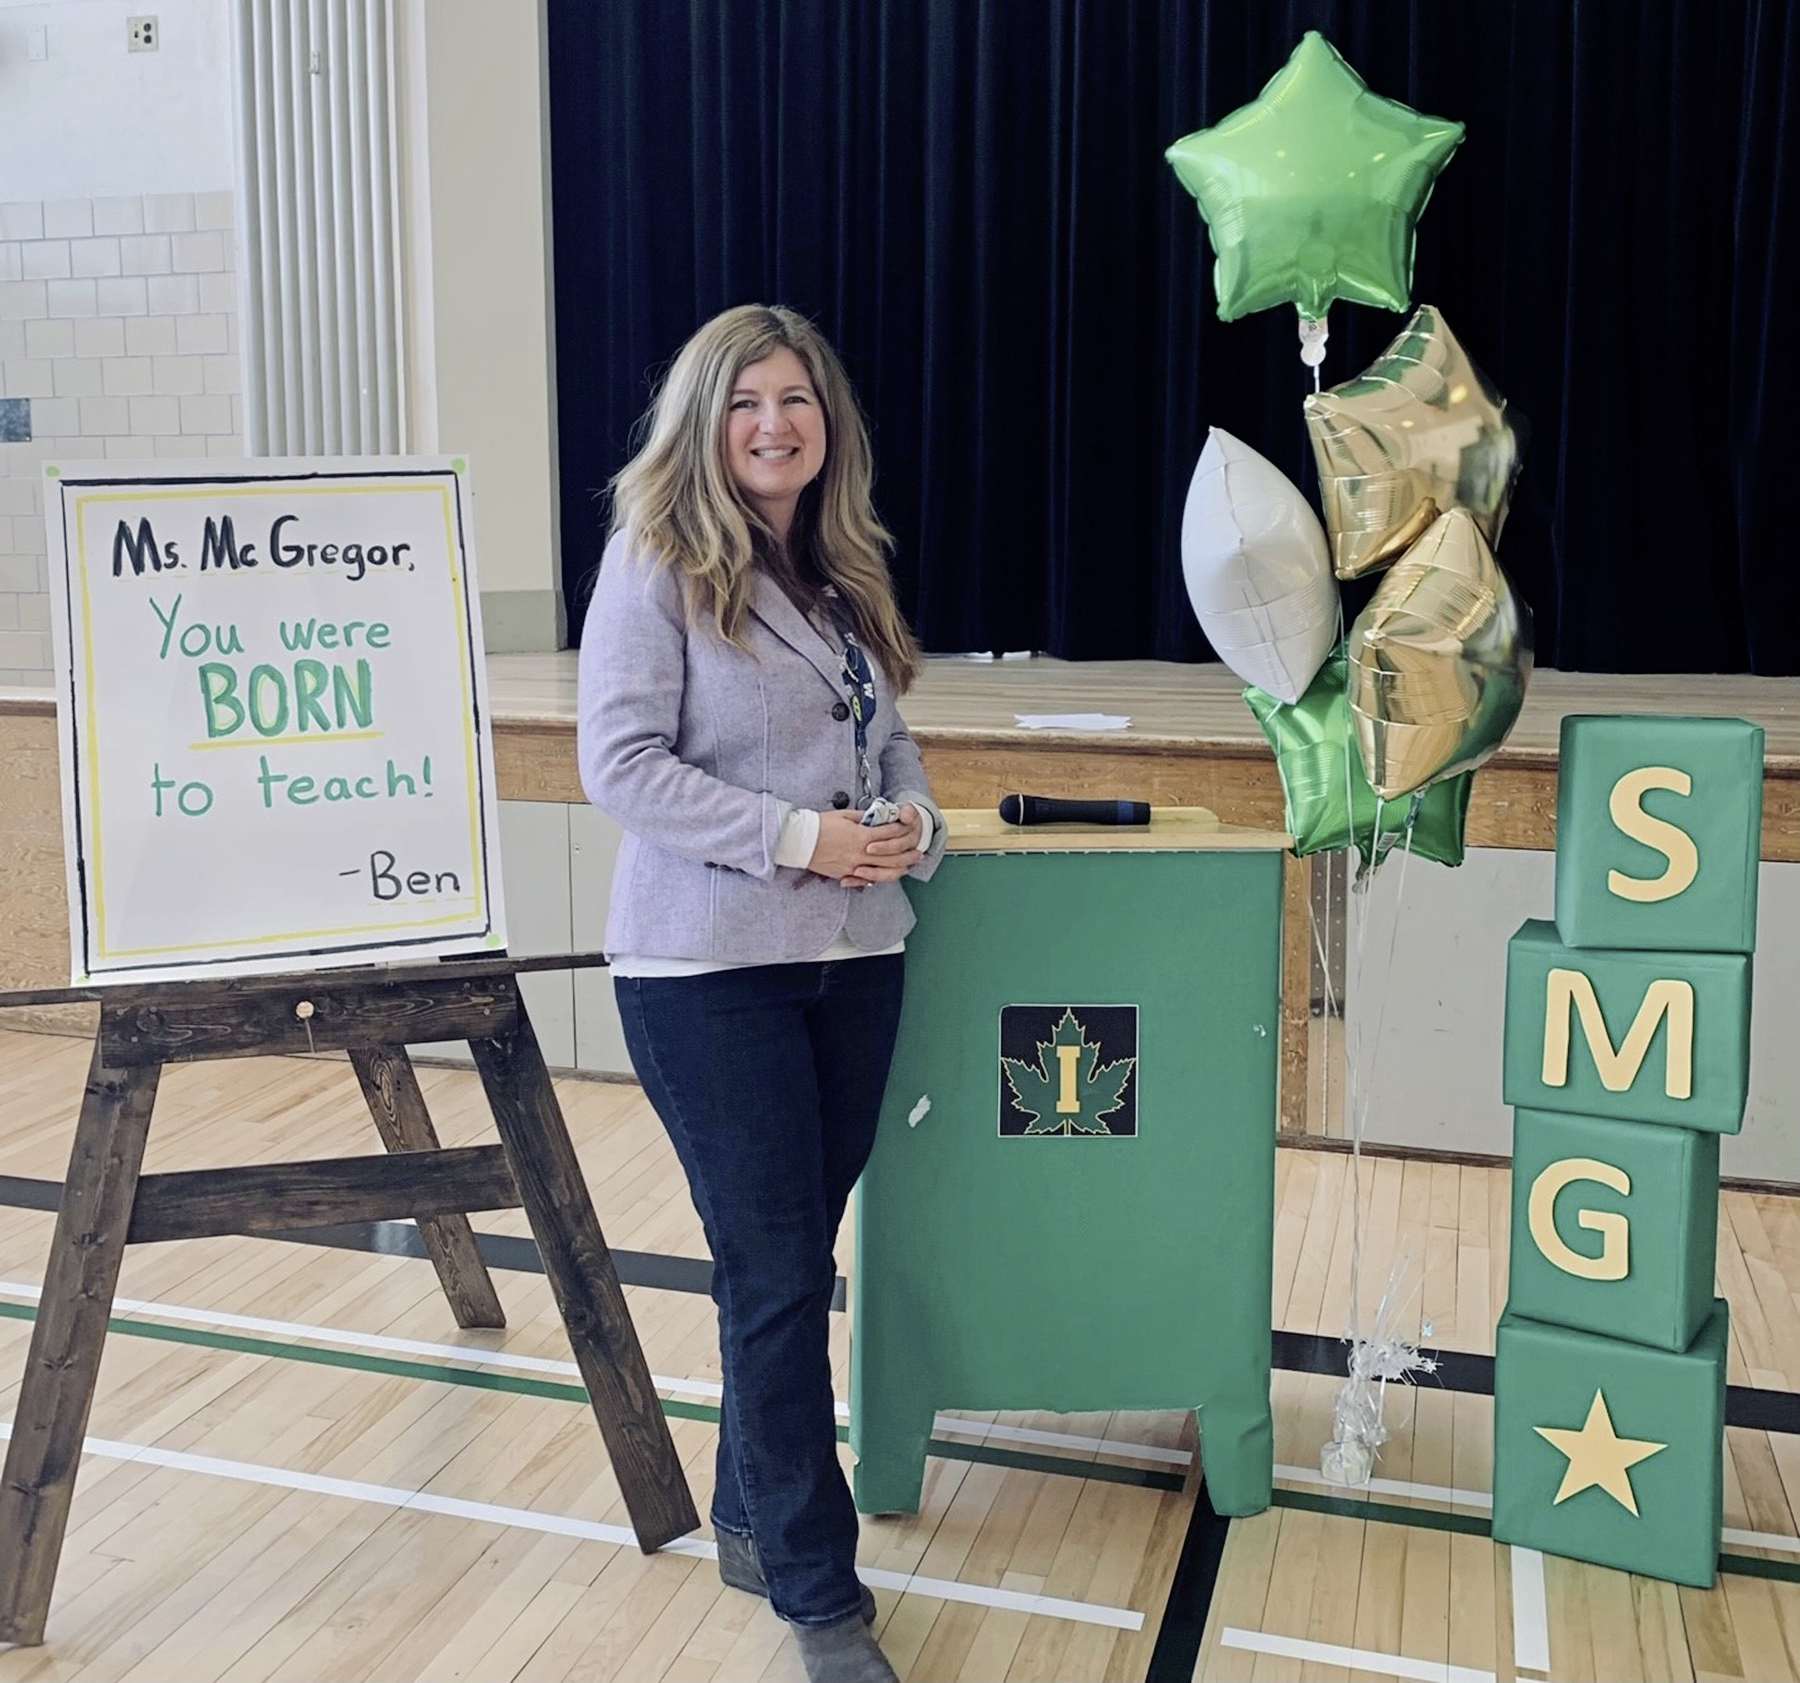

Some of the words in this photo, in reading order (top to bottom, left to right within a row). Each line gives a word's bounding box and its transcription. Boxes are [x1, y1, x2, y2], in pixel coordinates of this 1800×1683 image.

[112, 515, 187, 577] Ms.
[150, 594, 245, 659] You
[280, 617, 391, 651] were
[198, 658, 372, 738] BORN
[151, 763, 214, 817] to
[258, 755, 433, 808] teach!
